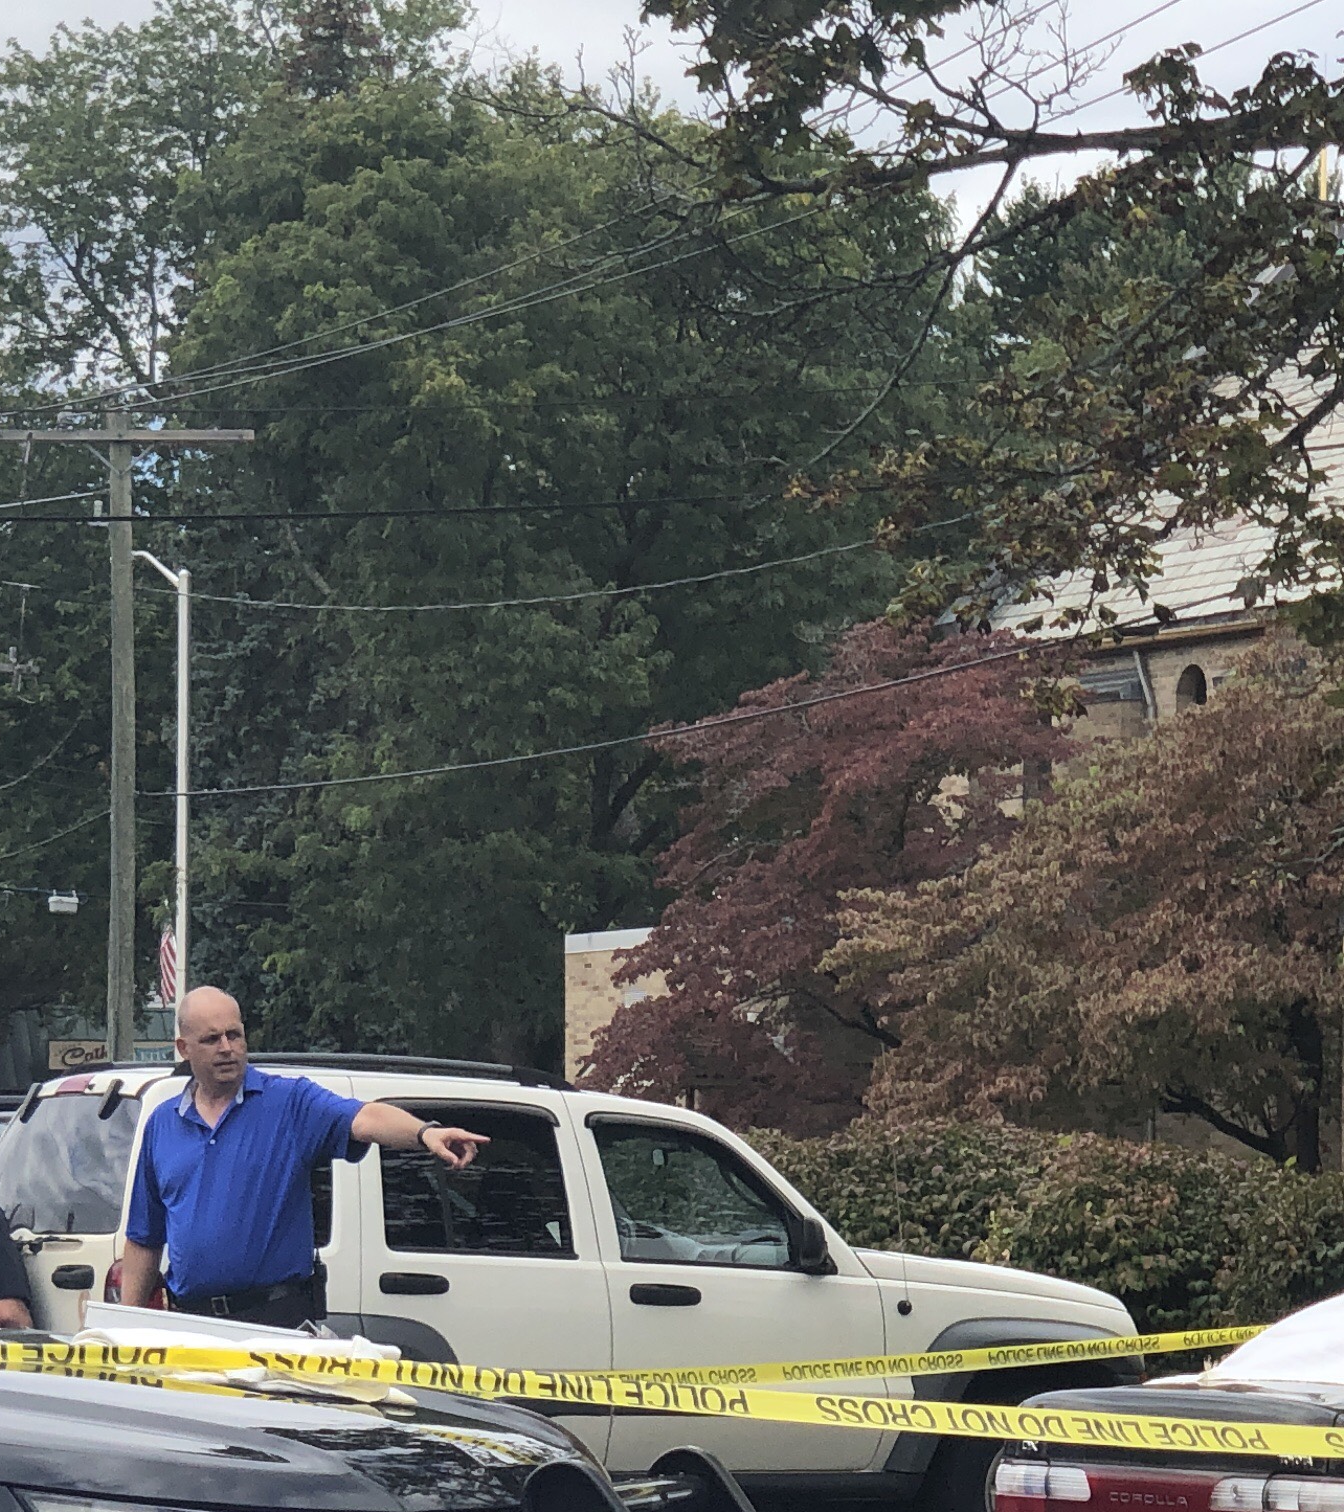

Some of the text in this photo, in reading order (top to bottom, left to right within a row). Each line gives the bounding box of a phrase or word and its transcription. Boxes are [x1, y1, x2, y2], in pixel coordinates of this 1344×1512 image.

[536, 1370, 616, 1404] LINE
[620, 1378, 750, 1414] POLICE
[815, 1395, 1270, 1451] POLICE LINE DO NOT CROSS
[1109, 1491, 1189, 1508] COROLLA
